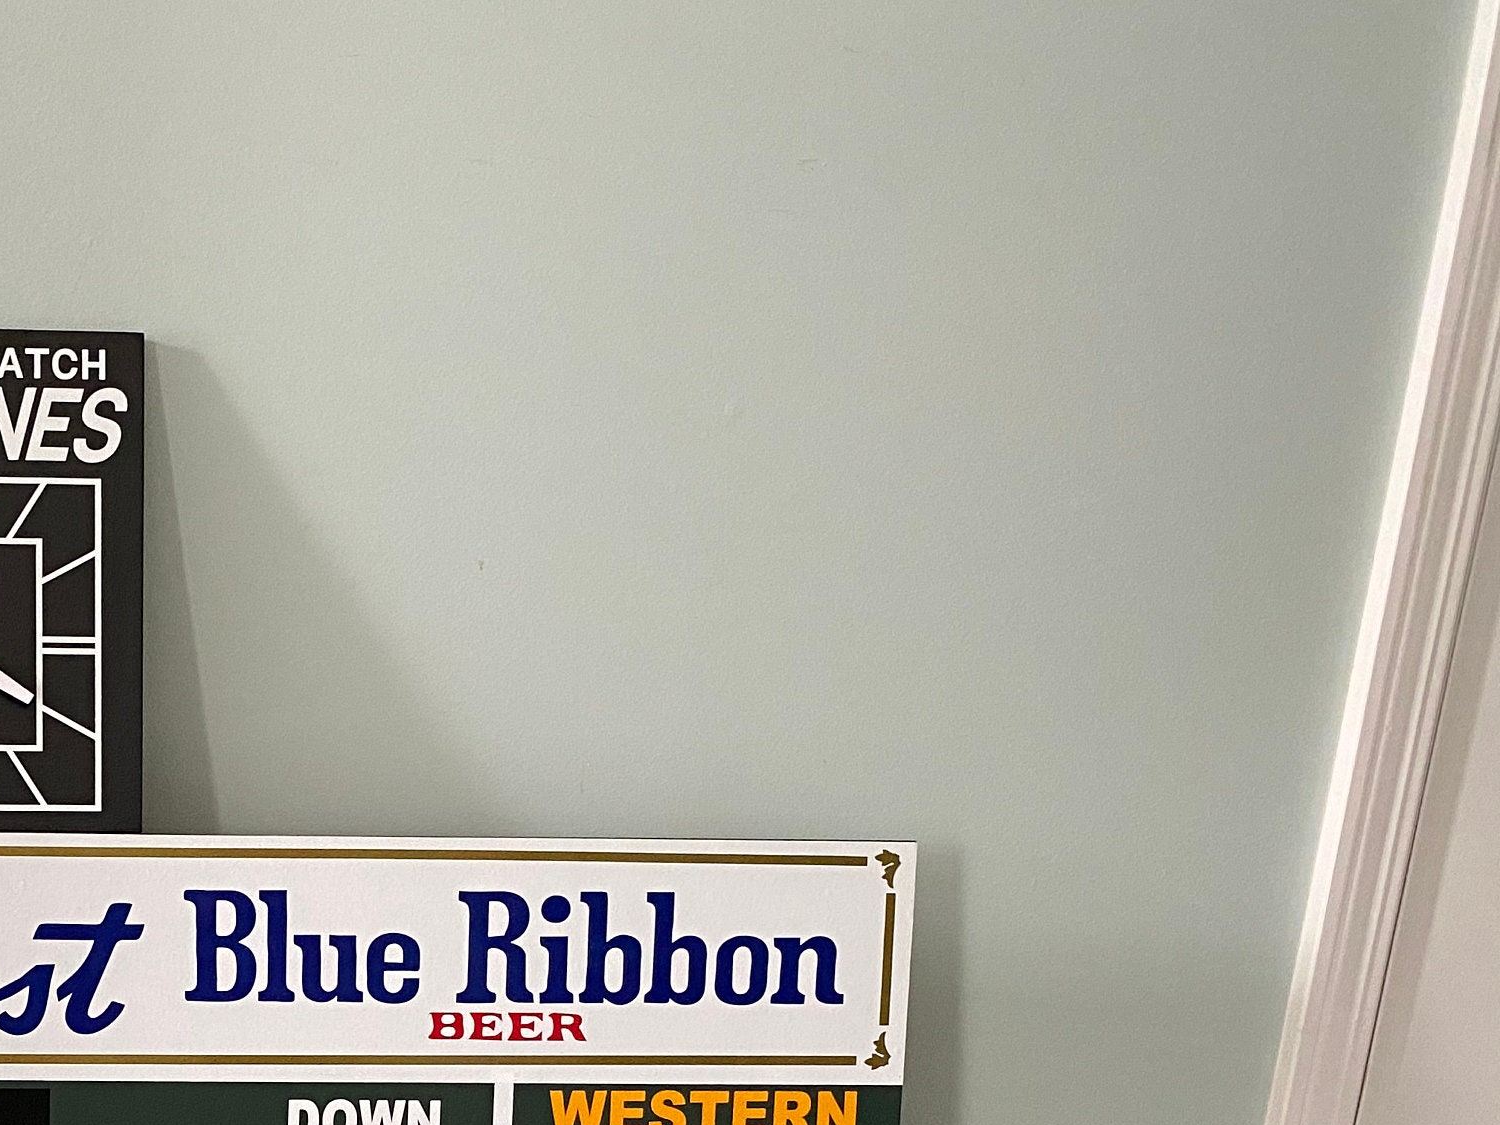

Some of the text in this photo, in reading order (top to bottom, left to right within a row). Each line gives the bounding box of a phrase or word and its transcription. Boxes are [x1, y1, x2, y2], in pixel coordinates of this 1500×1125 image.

[183, 889, 421, 1004] Blue
[455, 890, 845, 1006] Ribbon
[428, 1011, 587, 1042] BEER
